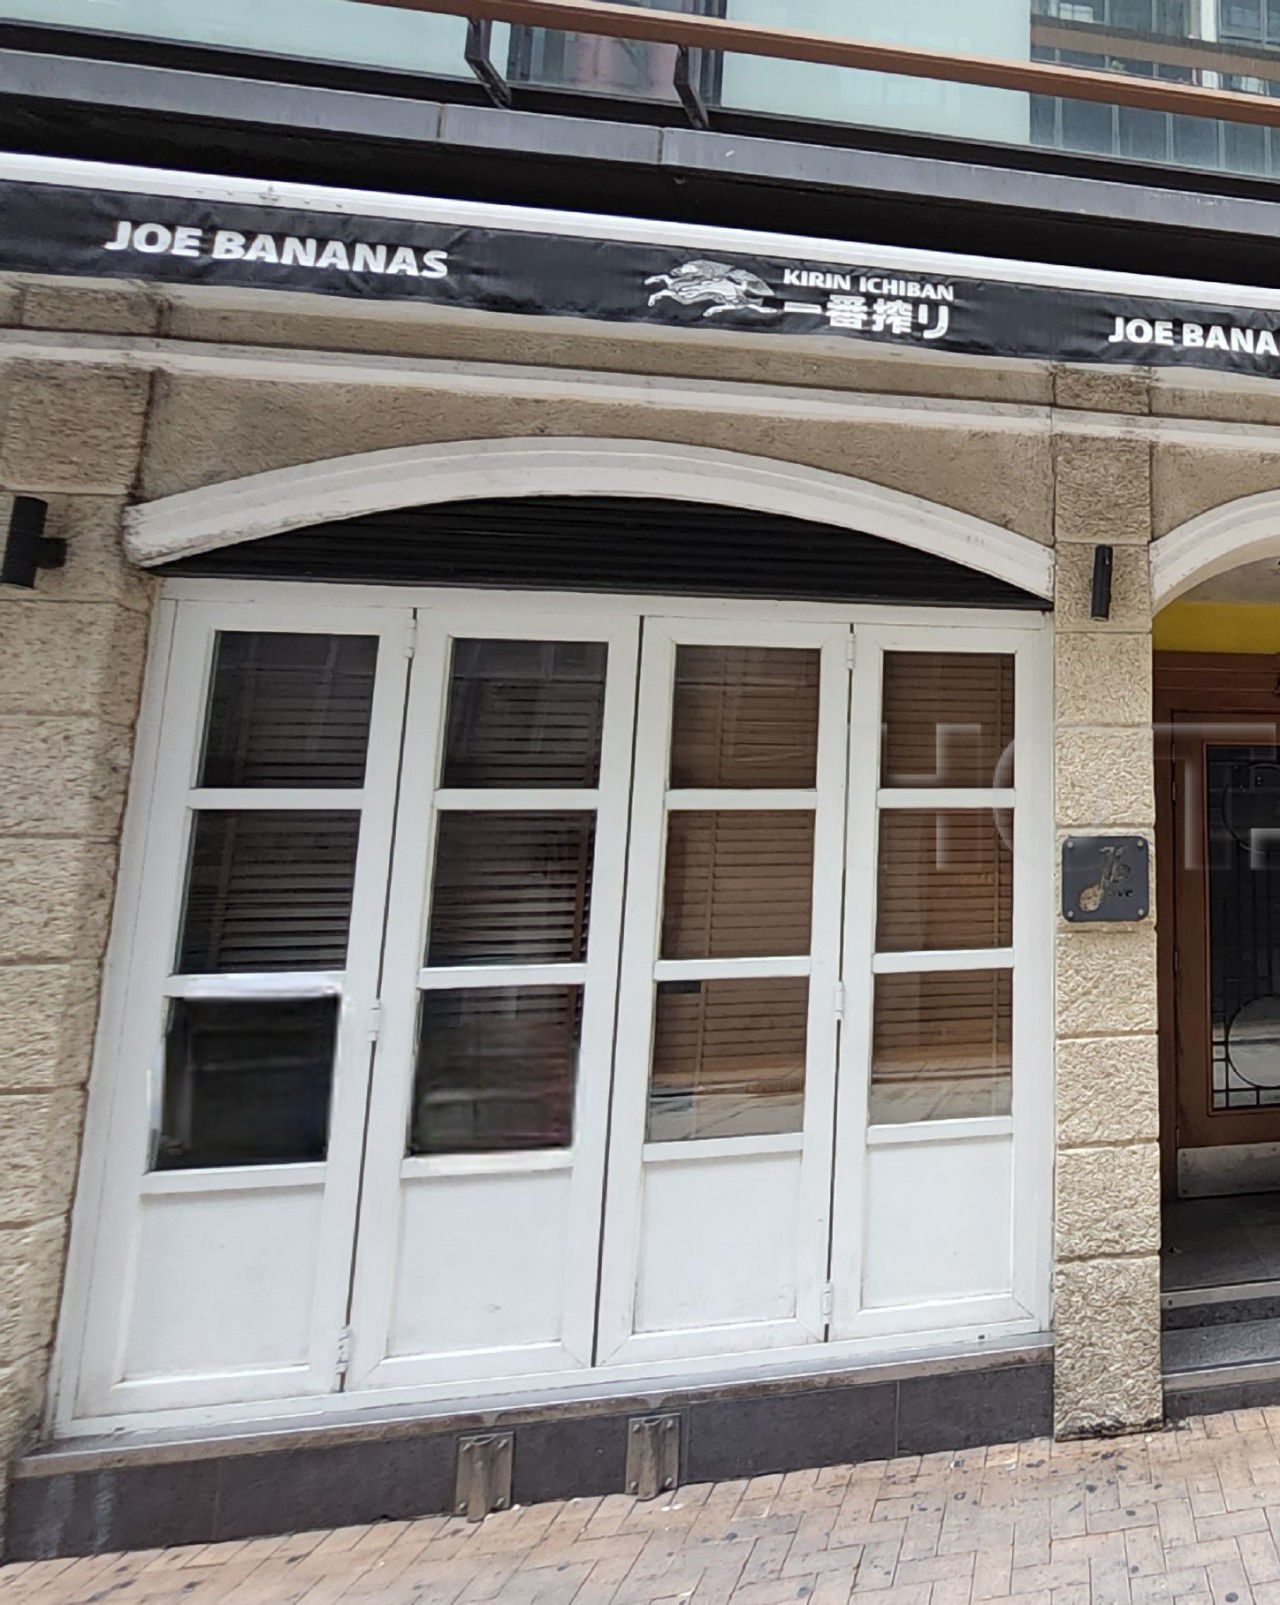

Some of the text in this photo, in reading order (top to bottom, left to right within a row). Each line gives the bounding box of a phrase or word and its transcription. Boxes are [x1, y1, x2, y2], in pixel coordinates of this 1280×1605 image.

[104, 221, 448, 279] JOE BANANAS
[783, 268, 954, 301] KIRIN ICHIBAN
[783, 294, 949, 340] 一番搾り
[1109, 317, 1174, 345] JOE
